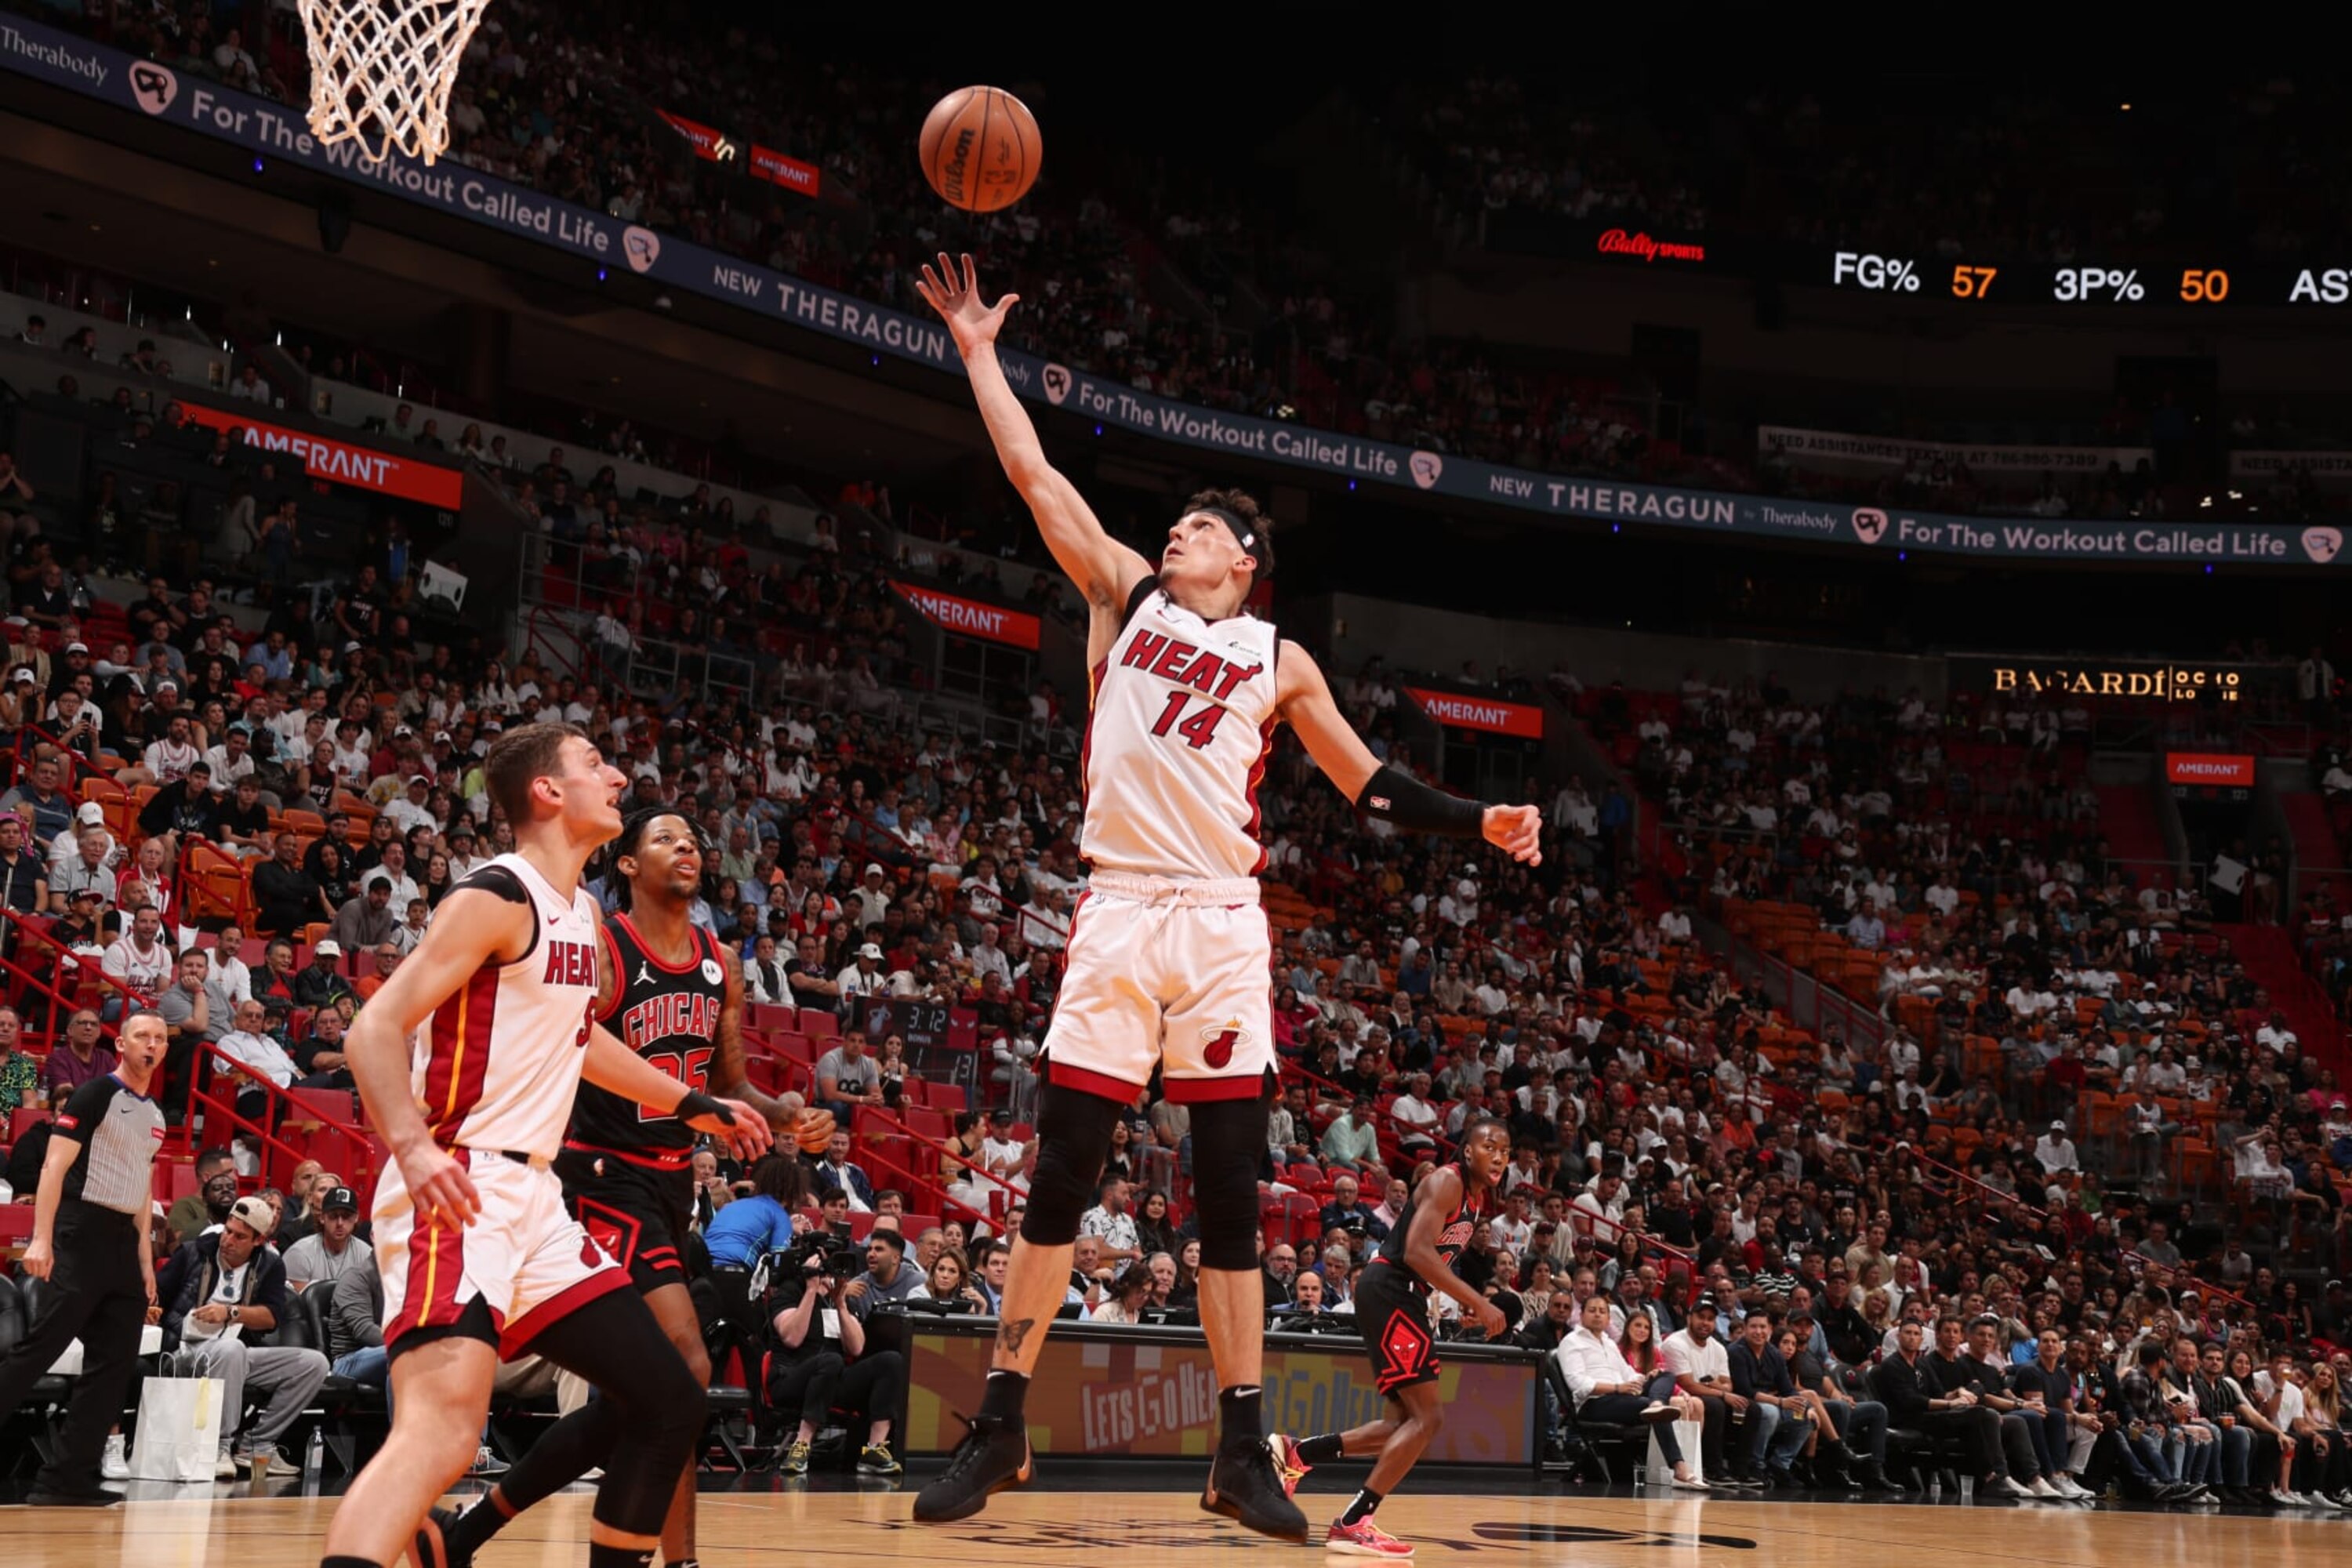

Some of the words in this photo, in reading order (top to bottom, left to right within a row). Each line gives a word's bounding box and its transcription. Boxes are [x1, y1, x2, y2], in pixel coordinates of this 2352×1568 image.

[2, 26, 108, 87] Therabody
[192, 89, 248, 135] For
[255, 109, 313, 155] The
[462, 181, 552, 234] Called
[559, 211, 610, 252] Life
[1597, 227, 1659, 263] Bally
[1658, 241, 1706, 263] SPORTS
[1834, 251, 1921, 292] FG%
[1952, 265, 1998, 299] 57
[2053, 267, 2145, 302] 3P%
[2180, 270, 2229, 303] 50
[714, 265, 762, 298] NEW
[778, 281, 946, 363] THERAGUN
[1079, 382, 1115, 416] For
[1118, 394, 1156, 427] The
[1160, 407, 1266, 452] Workout
[1271, 430, 1348, 467] Called
[1354, 446, 1399, 476] Life
[1490, 474, 1534, 499] NEW
[1547, 482, 1735, 524] THERAGUN
[1761, 505, 1838, 533] Therabody
[1898, 518, 1943, 543] For
[1947, 523, 1996, 549] The
[2002, 526, 2126, 553] Workout
[2133, 528, 2223, 555] Called
[2232, 532, 2287, 557] Life
[909, 592, 1004, 635] AMERANT
[1120, 628, 1264, 702] HEAT
[1150, 690, 1229, 750] 14
[1425, 697, 1508, 728] AMERANT
[2176, 762, 2239, 776] AMERANT
[622, 991, 722, 1051] CHICAG
[907, 1005, 947, 1033] 3:12
[1082, 1385, 1135, 1450] LETS
[1178, 1360, 1218, 1427] HEA
